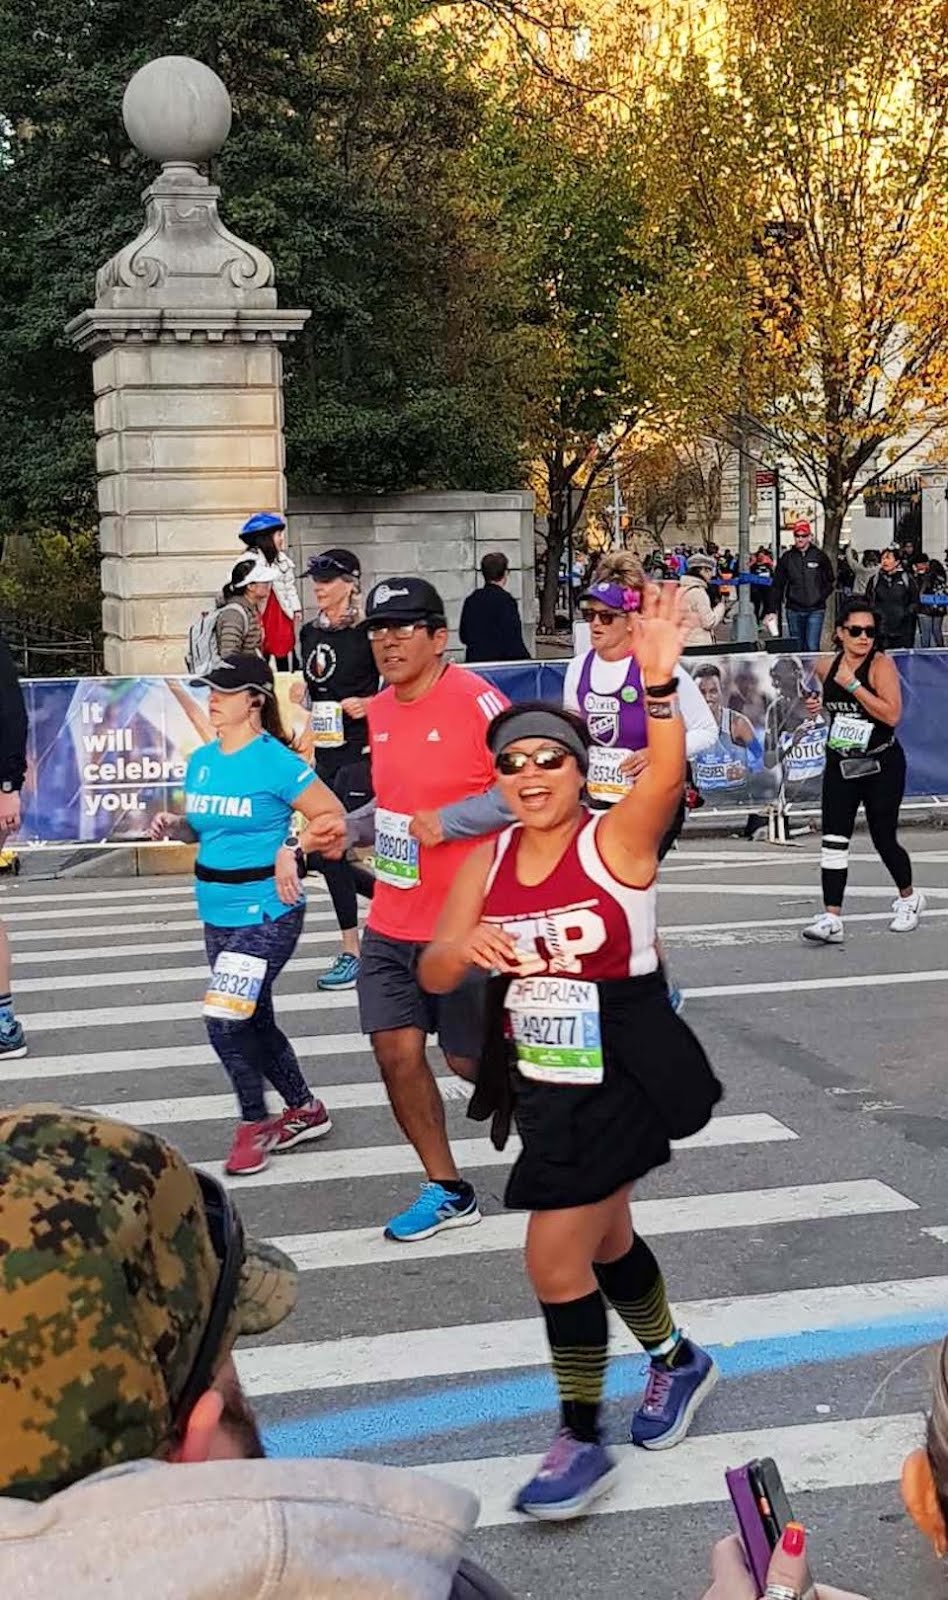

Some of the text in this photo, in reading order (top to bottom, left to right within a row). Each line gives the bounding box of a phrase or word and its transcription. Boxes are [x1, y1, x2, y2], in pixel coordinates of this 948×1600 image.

[82, 702, 104, 724] It
[83, 729, 133, 752] will
[85, 792, 146, 816] you.
